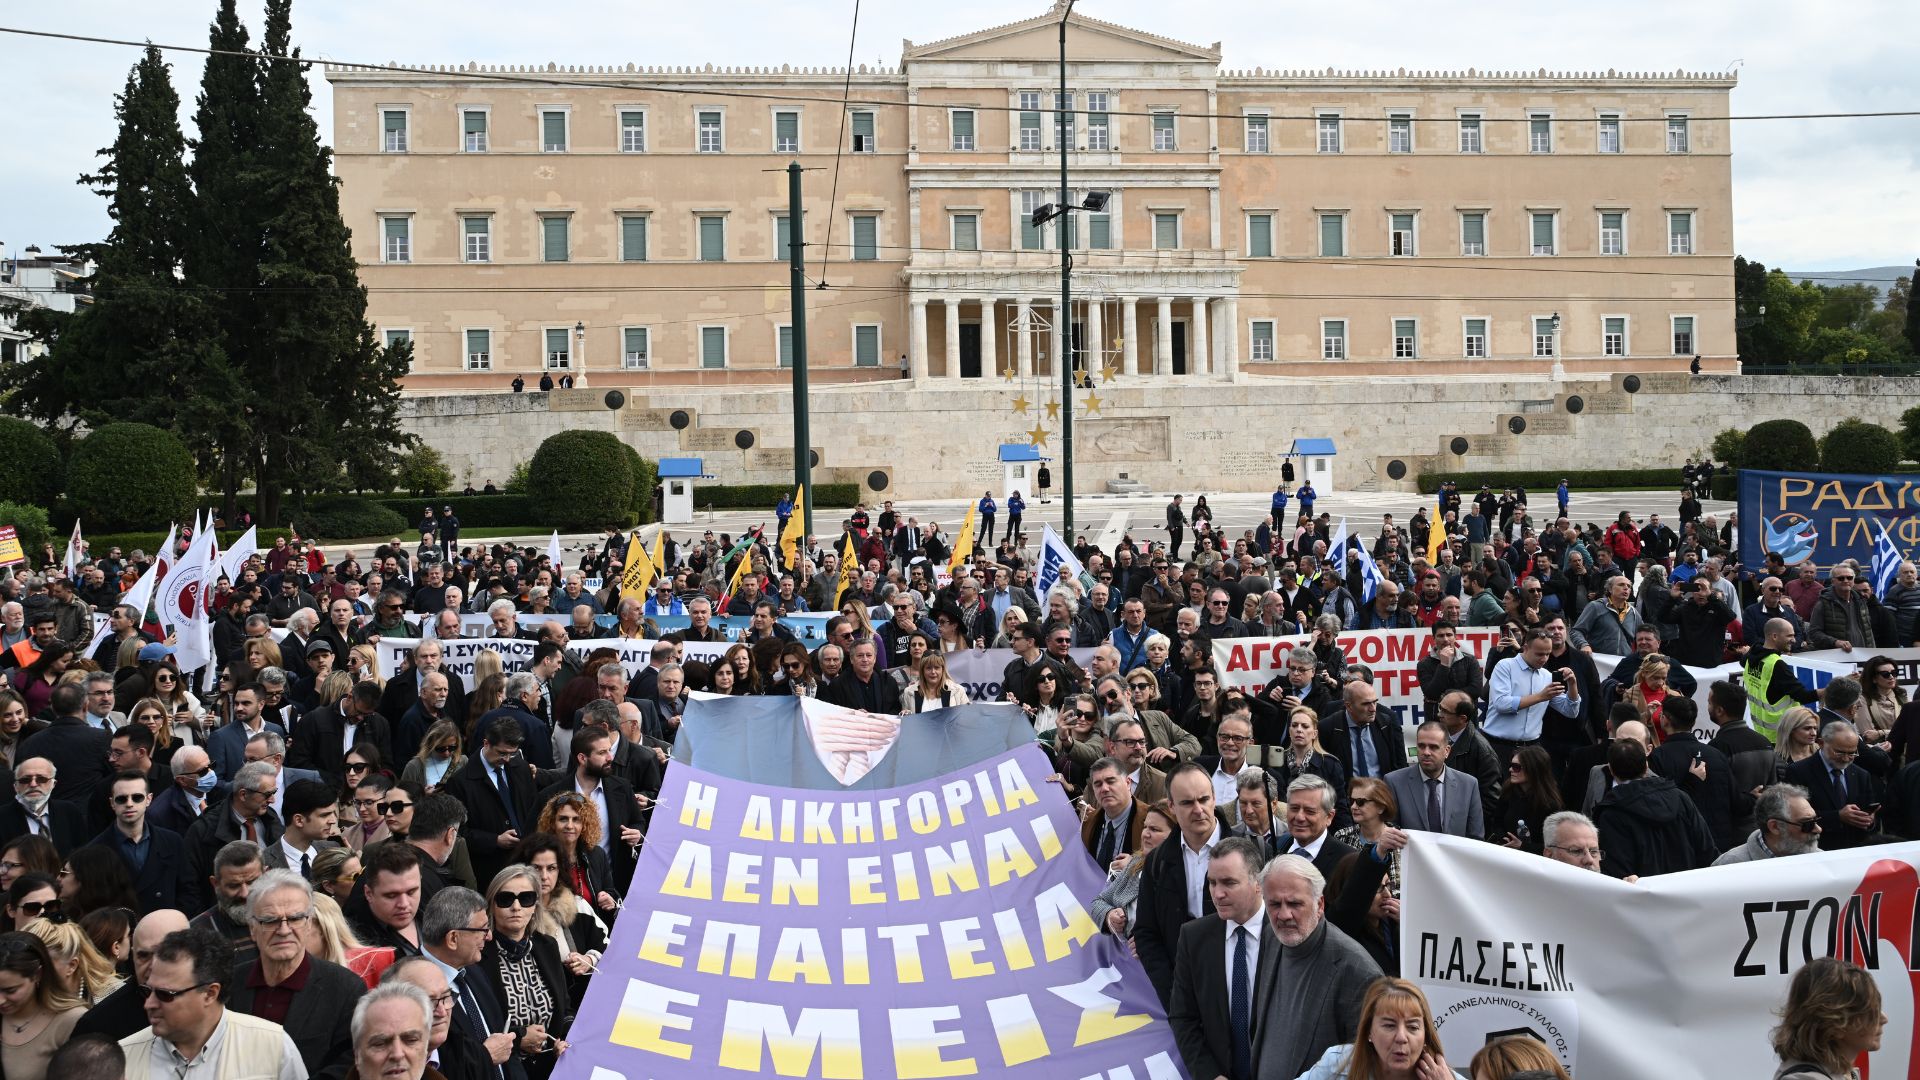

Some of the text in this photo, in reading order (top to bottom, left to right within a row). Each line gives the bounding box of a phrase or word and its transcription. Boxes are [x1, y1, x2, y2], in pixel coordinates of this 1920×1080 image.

[1780, 478, 1920, 511] ΡΑΔΙ
[679, 758, 1039, 845] Η ΔΙΚΗΓΟΡΙΑ
[659, 814, 1063, 906] ΔΕΝ ΕΙΝΑΙ
[638, 882, 1101, 986] ΕΠΑΙΤΕΙΑ
[1419, 932, 1574, 992] Π.Α.Σ.Ε.Ε.Μ.
[1734, 892, 1882, 977] ΣΤΟΝ
[609, 963, 1154, 1080] ΕΜΕΙΣ
[1449, 996, 1528, 1016] ΠΑΝΕΛΛΗΝΙΟΣ
[1527, 1007, 1568, 1053] ΣΥΛΛΟΓΟΣ
